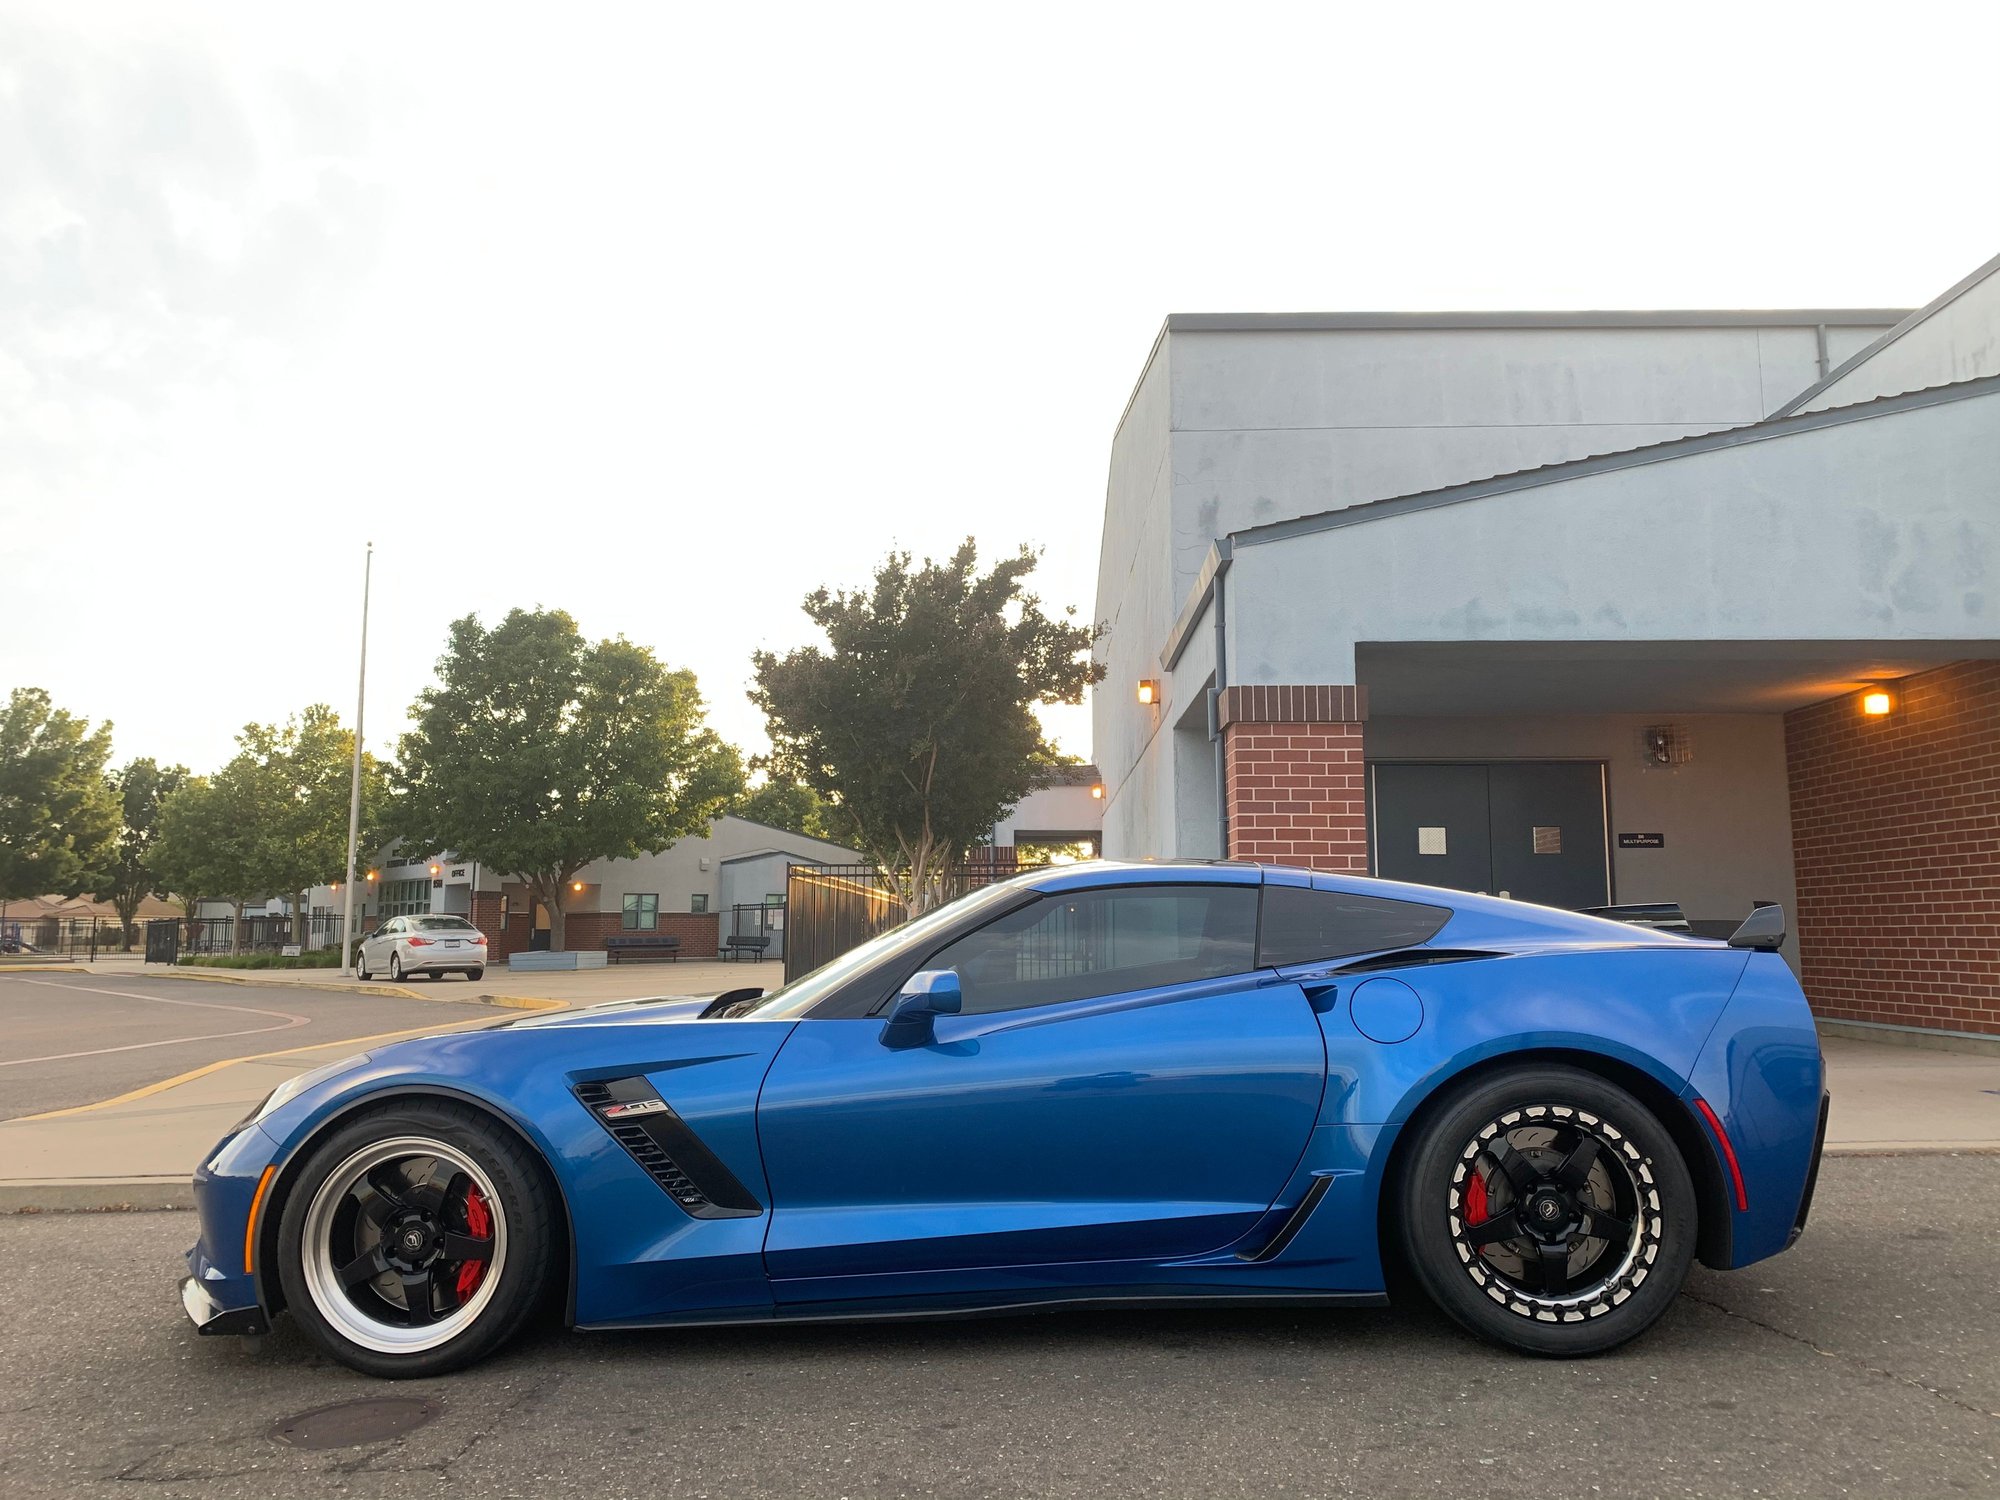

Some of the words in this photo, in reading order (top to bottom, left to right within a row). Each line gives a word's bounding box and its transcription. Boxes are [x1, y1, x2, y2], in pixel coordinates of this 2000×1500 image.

[451, 869, 465, 878] OFFICE
[602, 1098, 668, 1118] Z06
[475, 1147, 524, 1238] FEDERAL
